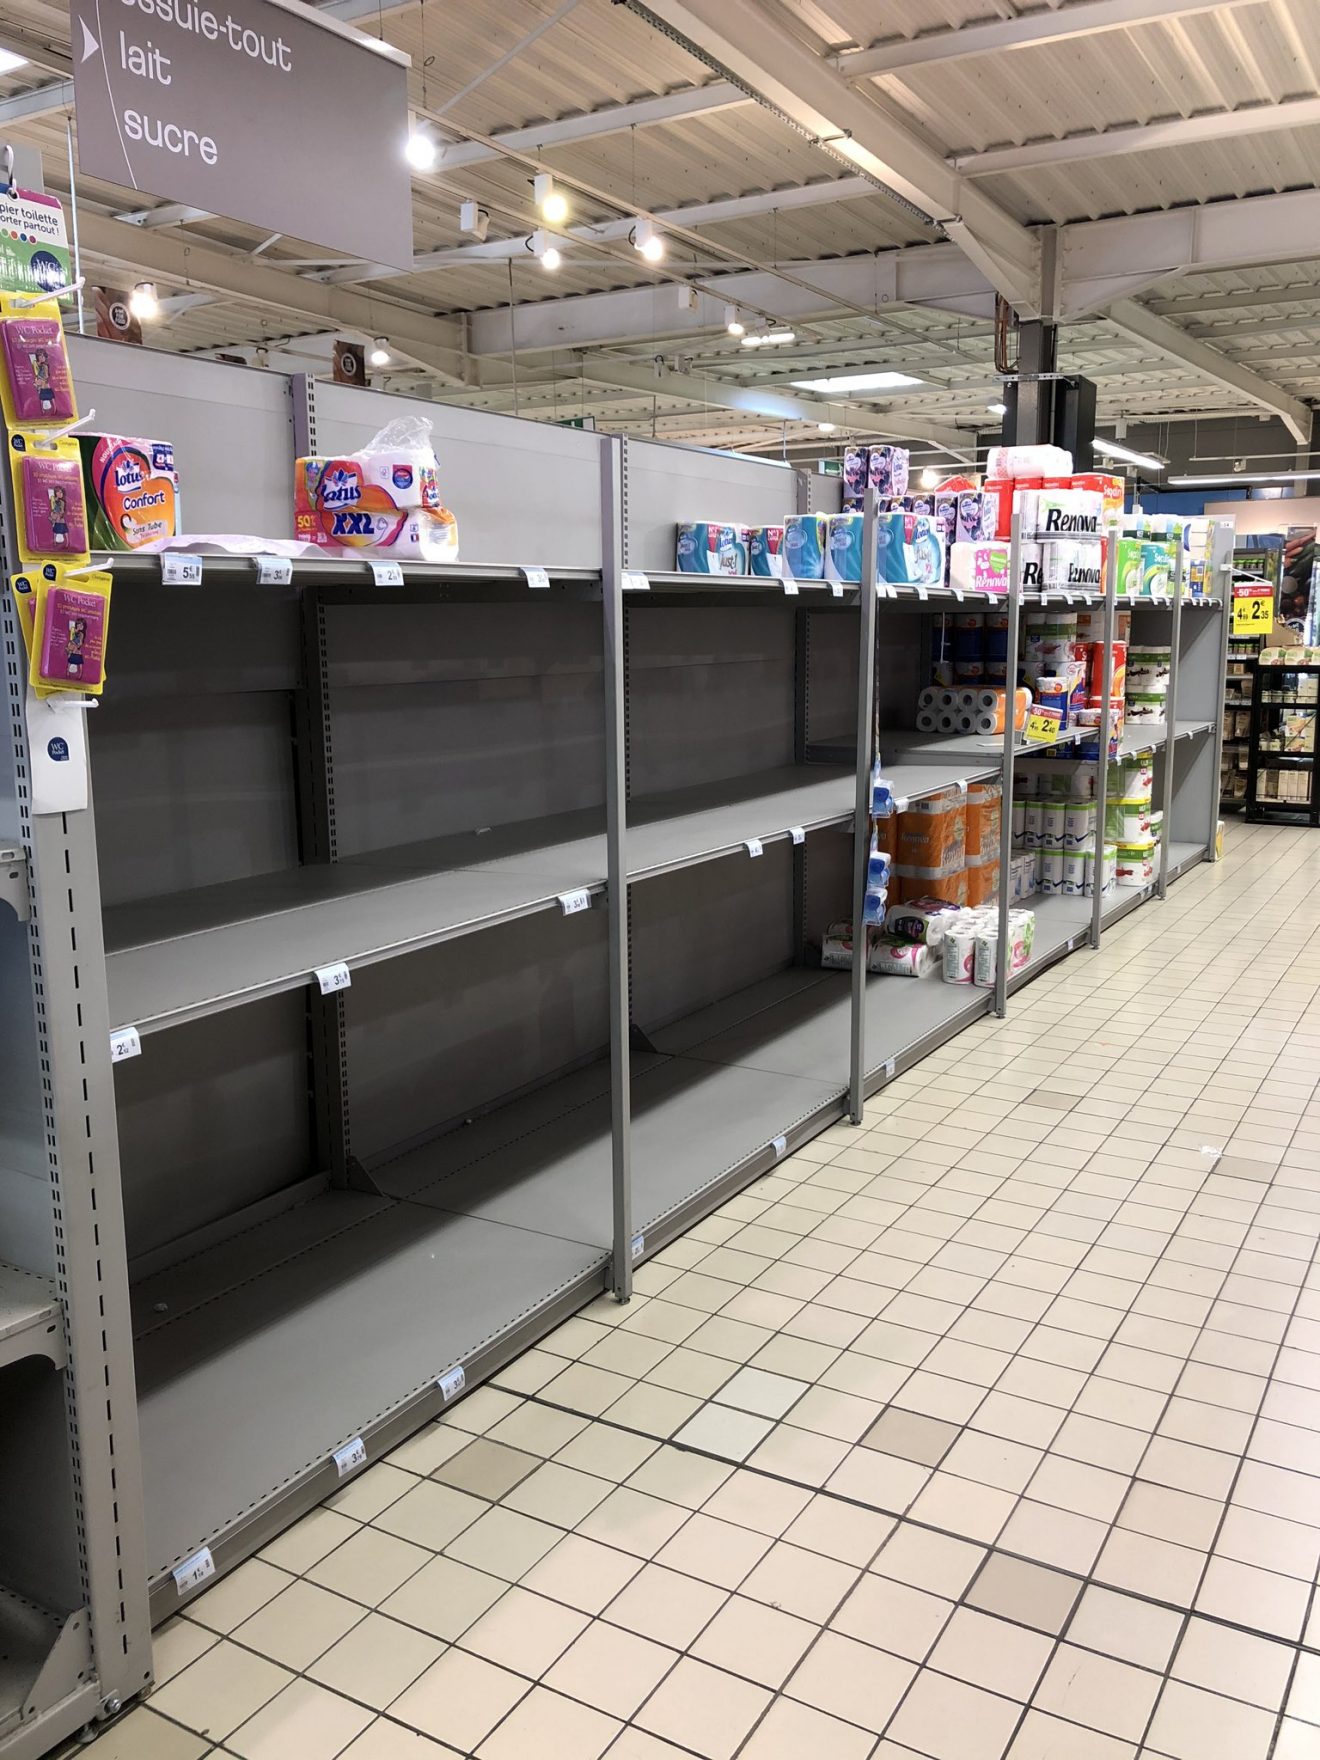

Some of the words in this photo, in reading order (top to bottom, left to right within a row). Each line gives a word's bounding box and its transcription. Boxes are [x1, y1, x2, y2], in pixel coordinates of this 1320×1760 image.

[121, 0, 293, 72] suie-tout
[119, 30, 172, 85] lait
[123, 109, 218, 165] sucre
[21, 208, 58, 225] toilette
[23, 221, 55, 235] partout
[114, 469, 145, 487] lotus
[123, 491, 165, 511] Confort
[320, 484, 362, 503] lotus
[332, 512, 375, 535] XXL
[1046, 508, 1098, 532] Renova
[50, 742, 65, 750] WC
